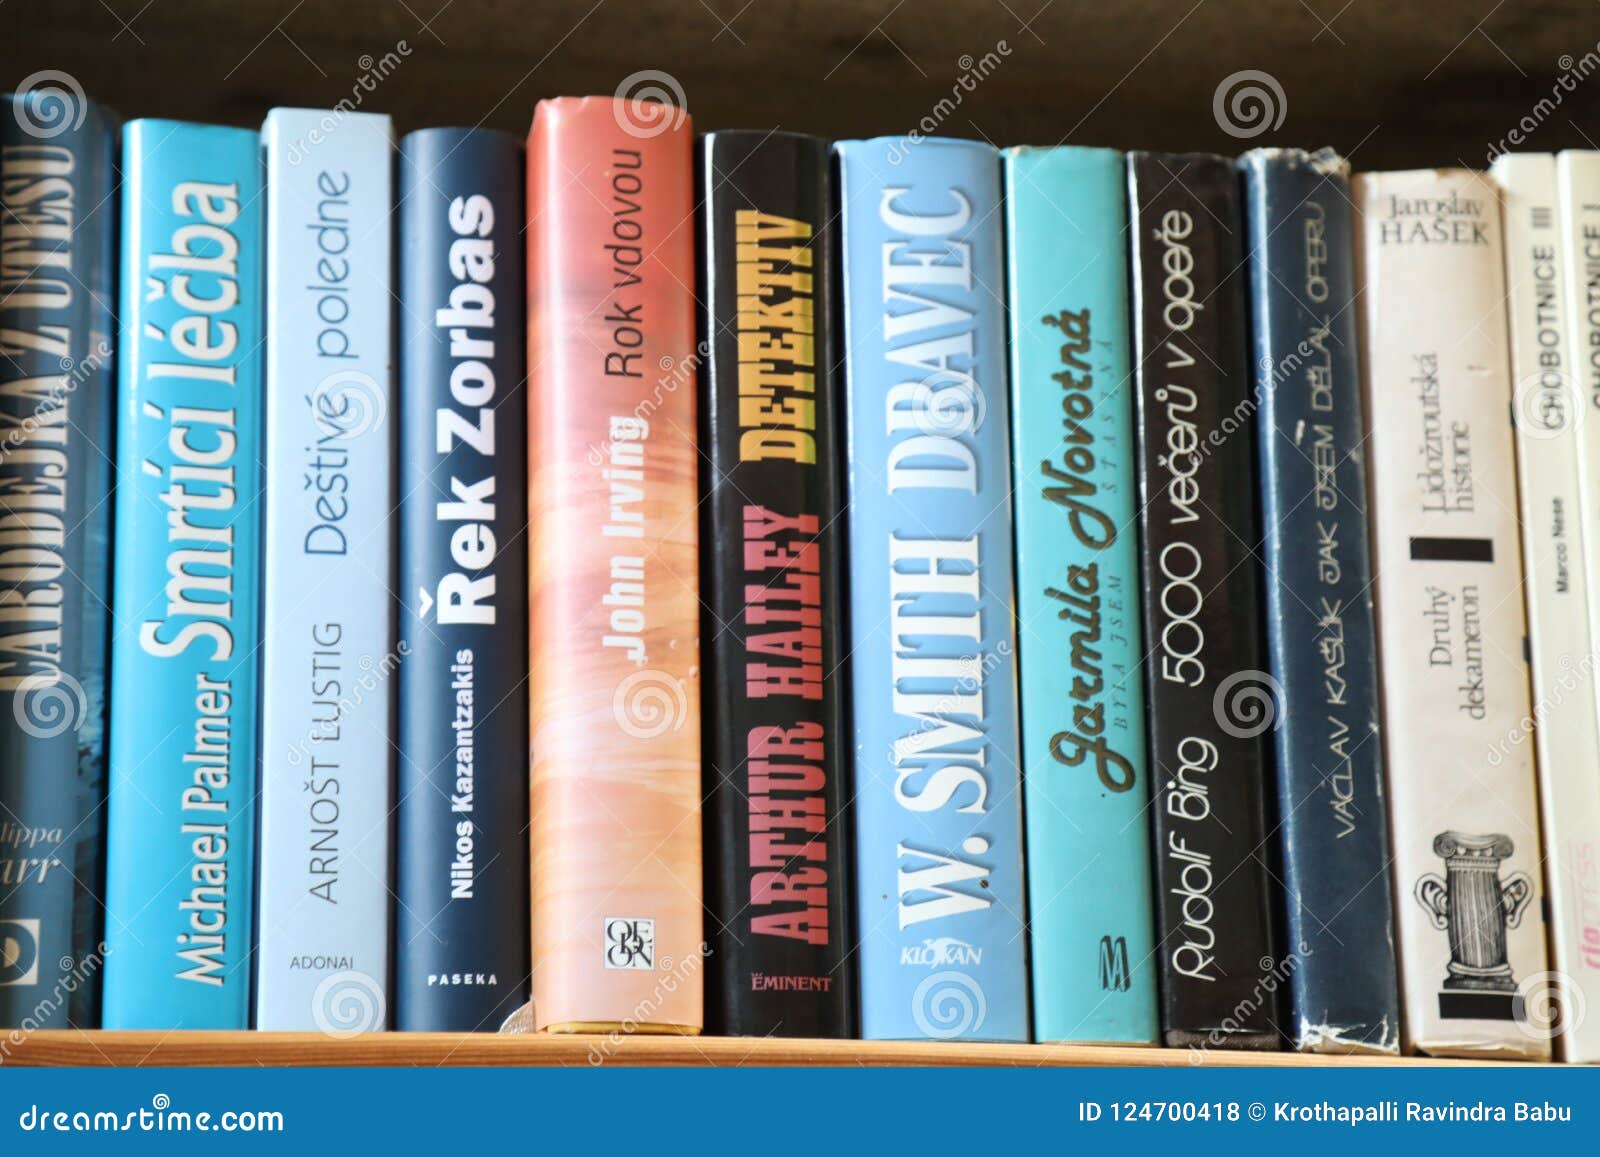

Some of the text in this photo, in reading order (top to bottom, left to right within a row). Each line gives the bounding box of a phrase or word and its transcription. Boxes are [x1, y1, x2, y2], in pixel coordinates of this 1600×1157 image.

[604, 149, 643, 378] Rok vdovou
[1305, 201, 1330, 301] OPERU
[1380, 217, 1490, 245] HAŠEK
[1387, 190, 1487, 220] Jaroslav
[0, 324, 70, 358] Z
[304, 170, 359, 556] Deštivé poledne
[1533, 246, 1565, 430] CHOBOTNICE
[1310, 427, 1337, 511] JSEM
[1412, 352, 1441, 514] Lidožroutská
[139, 180, 240, 986] Michael Palmer Smrtící léčba
[419, 193, 497, 899] Nikos Kazantzakis Řek Zorbas
[602, 414, 648, 665] John Irving
[735, 210, 829, 945] ARTHUR HAILEY DETEKTIV
[881, 187, 992, 931] W. SMITH DRAVEC
[1041, 307, 1135, 792] Jarmila Novotná
[1154, 210, 1218, 981] Rudolf Bing 5000 večerů v opeře
[1317, 521, 1341, 585] JAK
[1556, 542, 1568, 593] Marco
[1424, 585, 1459, 666] Druhý
[1459, 585, 1486, 721] dekameron
[303, 622, 342, 904] ARNOŠT LUSTIG
[290, 956, 353, 971] ADONAI
[428, 974, 498, 985] PASEKA
[751, 974, 832, 992] EMINENT
[900, 943, 982, 965] KLOKAN
